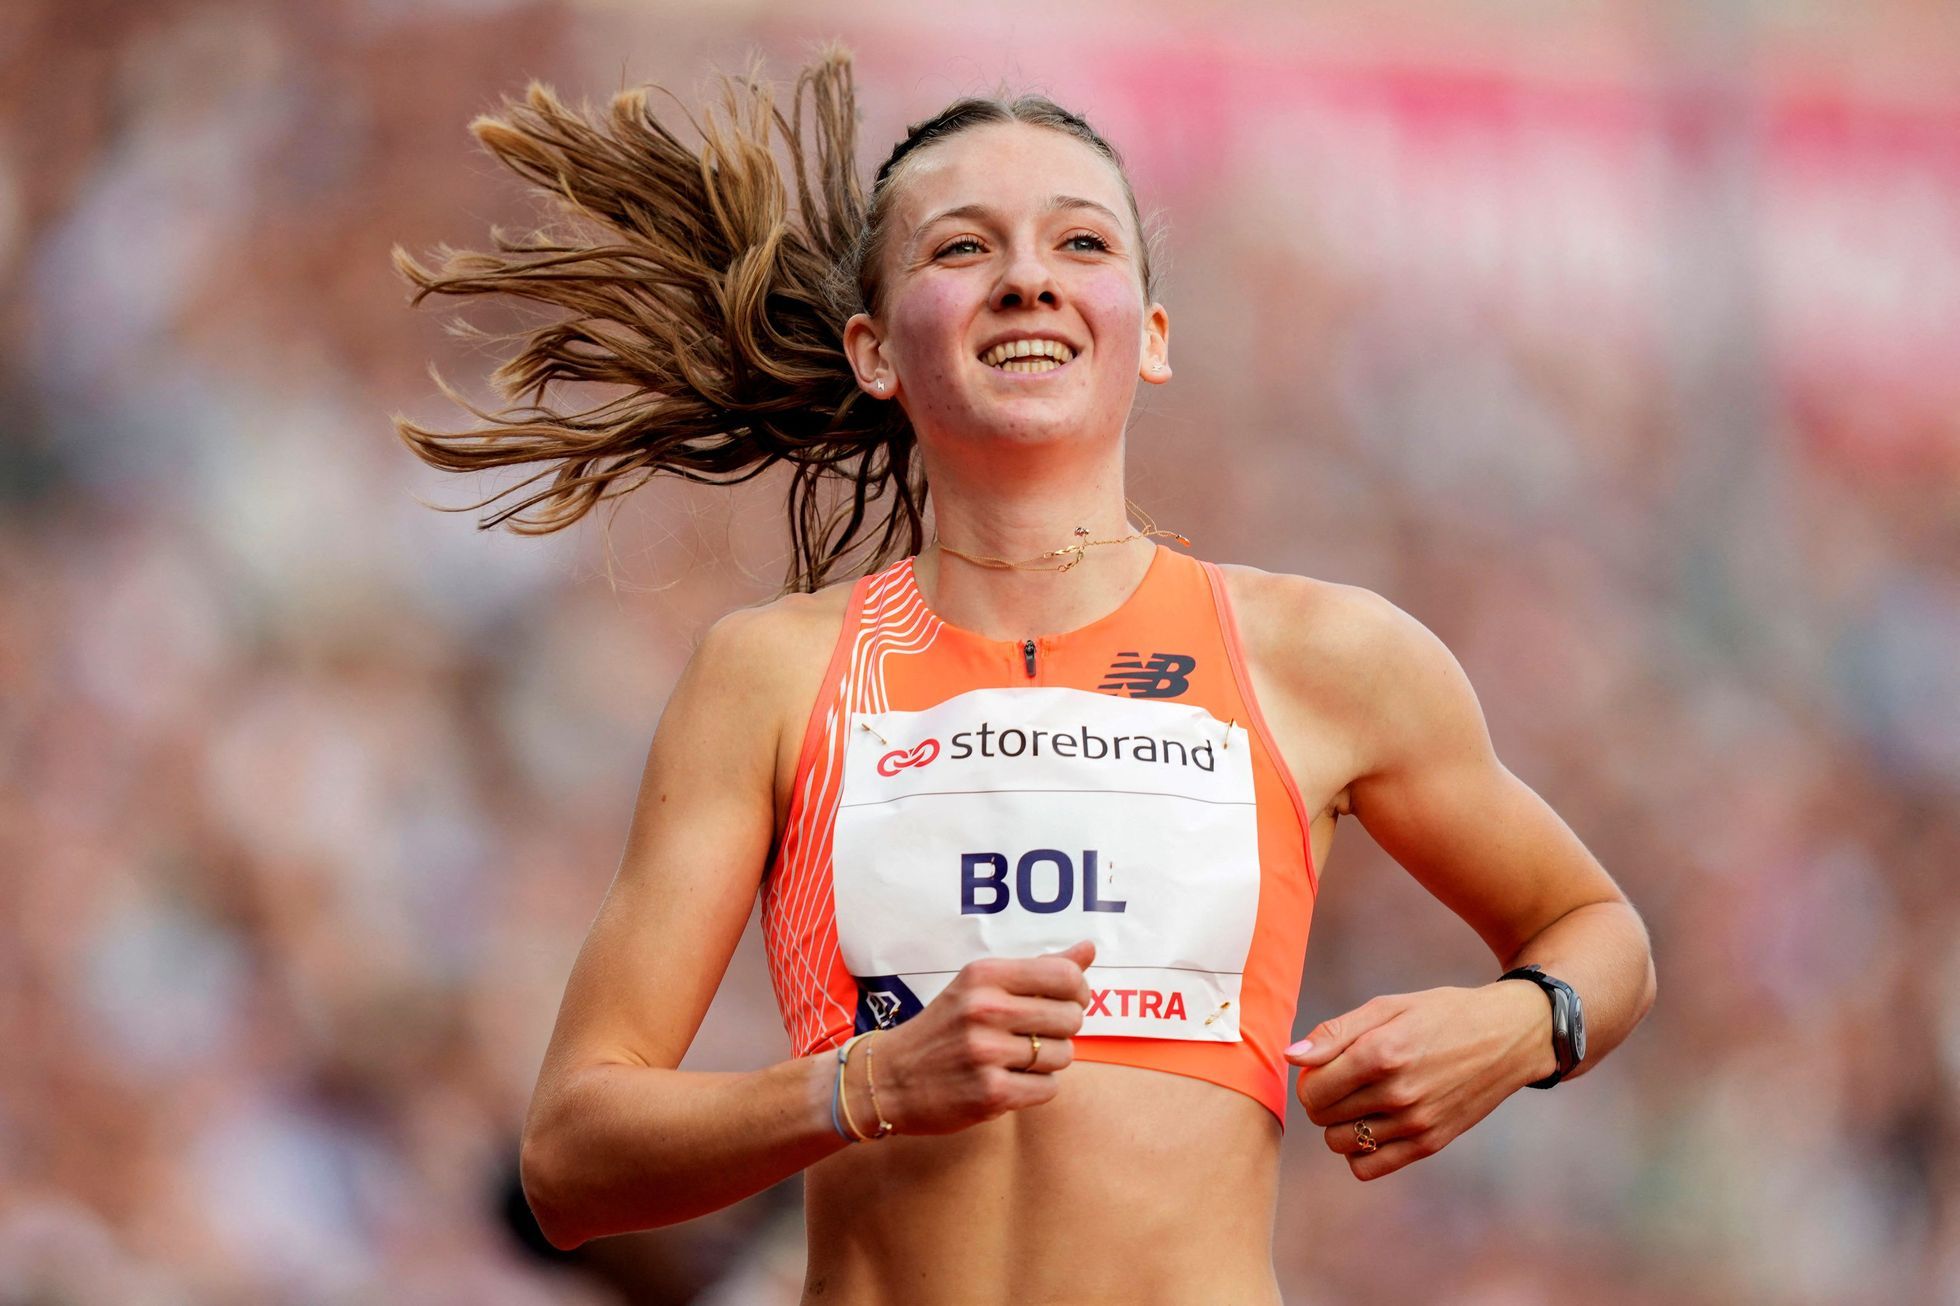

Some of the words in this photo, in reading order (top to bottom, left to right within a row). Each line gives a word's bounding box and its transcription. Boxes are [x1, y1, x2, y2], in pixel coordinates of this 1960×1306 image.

[1098, 652, 1196, 698] NB
[950, 722, 1215, 772] storebrand
[960, 848, 1127, 915] BOL
